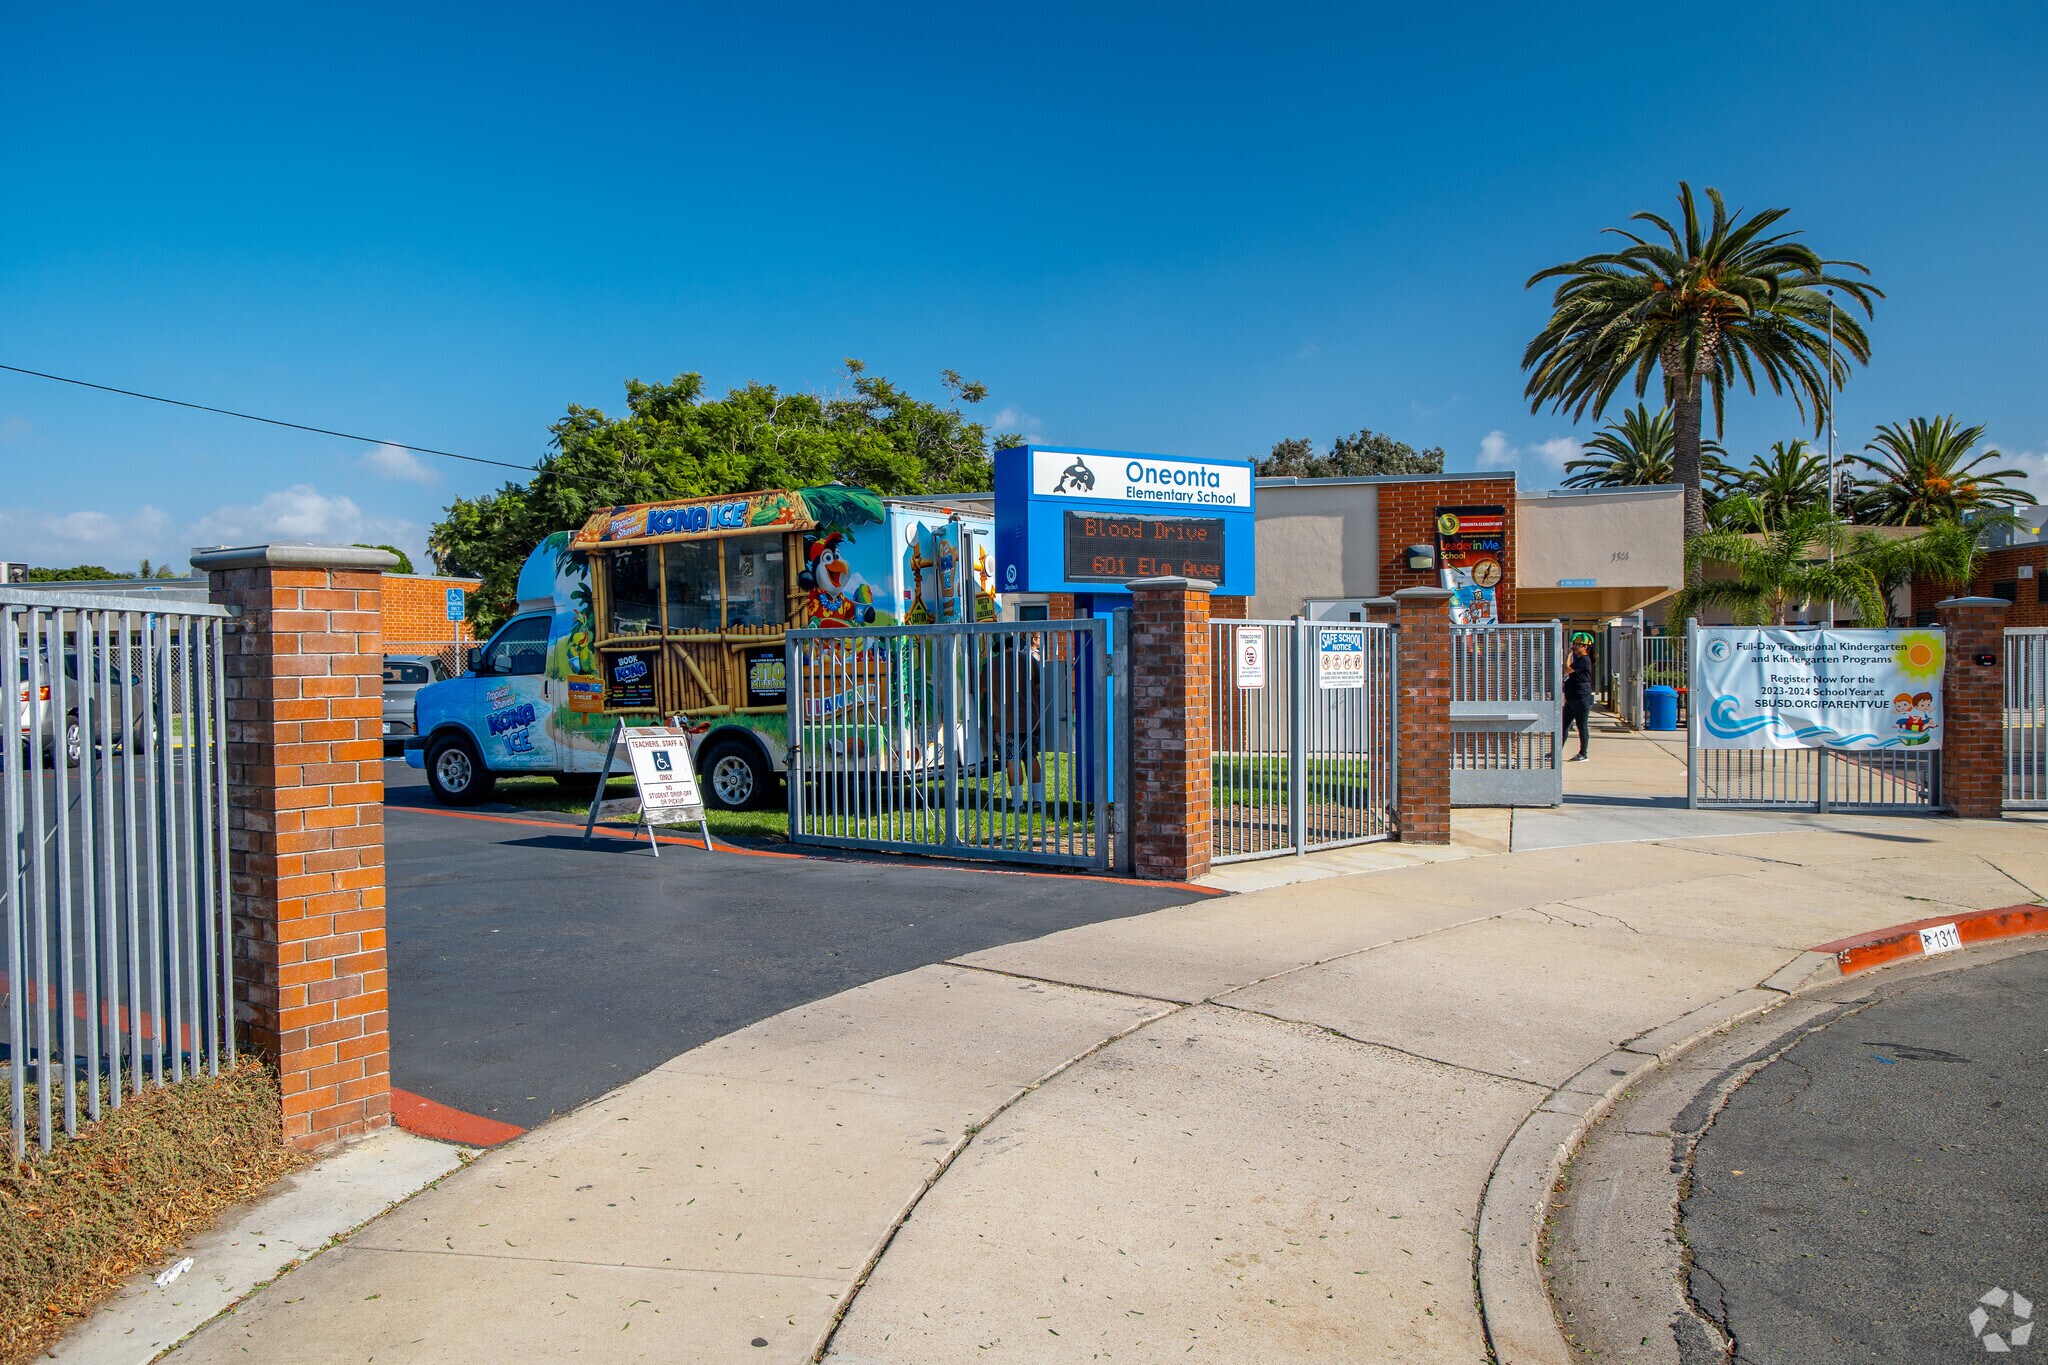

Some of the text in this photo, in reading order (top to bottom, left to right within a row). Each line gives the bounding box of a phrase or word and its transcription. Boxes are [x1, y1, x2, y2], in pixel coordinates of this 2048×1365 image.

[1126, 461, 1220, 488] Oneonta
[1126, 486, 1235, 504] Elementary School
[609, 514, 636, 533] Tropical
[646, 500, 749, 536] KONA ICE
[616, 523, 641, 539] Shaved
[1085, 518, 1208, 541] Blood Drive
[1440, 551, 1466, 560] School
[1091, 556, 1125, 575] 601
[1138, 557, 1172, 576] Elm
[1322, 633, 1362, 650] SAFE SCHOOL
[1736, 642, 1907, 653] Full-Day Transitional Kindergarten
[618, 655, 638, 666] BOOK
[1751, 655, 1892, 665] and Kindergarten Programs
[614, 661, 647, 682] KONA
[750, 662, 786, 680] $110
[1770, 675, 1875, 685] Register Now for the
[569, 681, 602, 693] KONA ICE
[751, 680, 786, 689] MILLION
[1761, 687, 1810, 695] 2023-2024
[1813, 687, 1847, 696] School
[1849, 688, 1871, 696] Year
[486, 685, 511, 703] Tropical
[492, 693, 516, 711] Shaved
[1755, 699, 1890, 709] SBUSD.ORG/PARENTVUE
[485, 703, 536, 737] KONA
[502, 728, 533, 756] ICE
[1934, 928, 1959, 948] 1311
